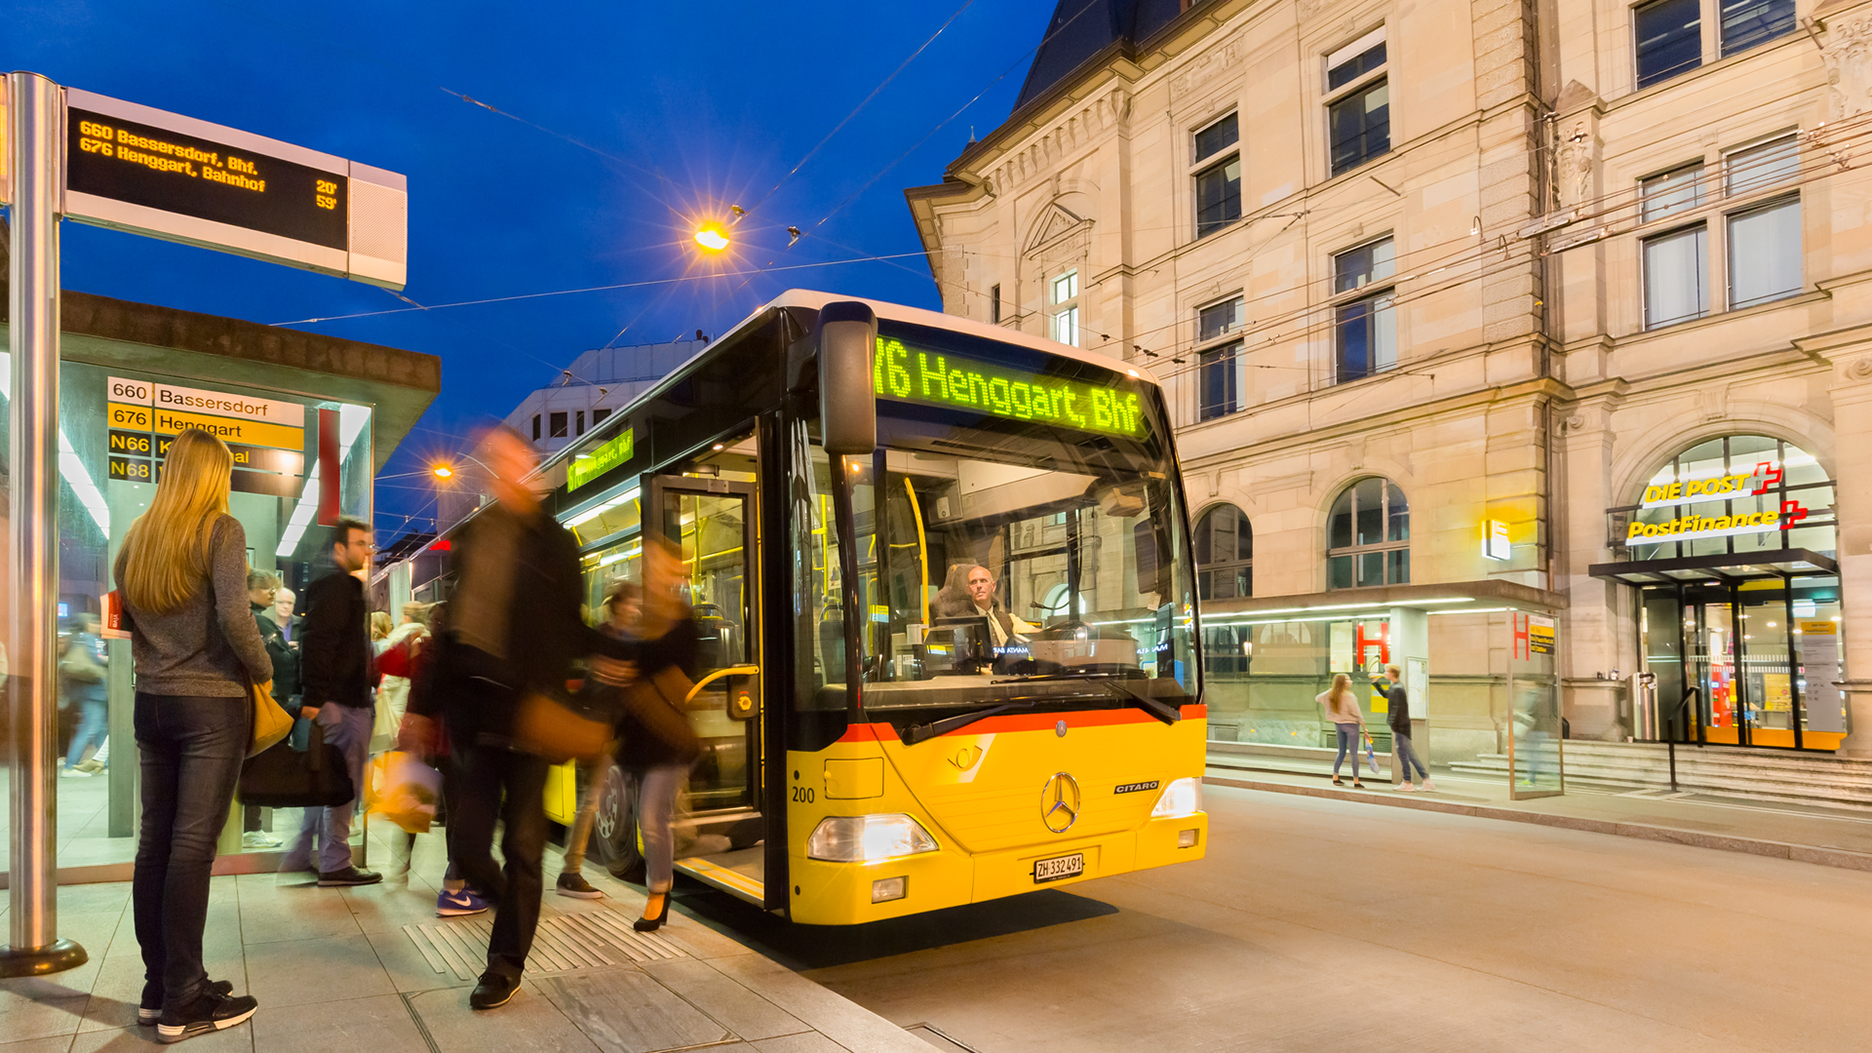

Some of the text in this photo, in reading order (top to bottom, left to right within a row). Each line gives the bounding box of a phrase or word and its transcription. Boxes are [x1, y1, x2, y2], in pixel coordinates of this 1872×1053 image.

[80, 120, 338, 195] 660 Bassersdorf, Bhf. 20'
[80, 137, 113, 156] 676
[117, 145, 197, 177] Henggart,
[202, 166, 266, 192] Bahnhof
[113, 383, 268, 416] 660 Bassersdorf
[918, 352, 1086, 428] Henggart,
[1090, 388, 1141, 432] Bhf
[113, 409, 147, 425] 676
[111, 434, 149, 452] N66
[111, 461, 149, 478] N68
[1645, 473, 1751, 503] DIE POST
[1627, 510, 1780, 540] PostFinance
[792, 785, 815, 804] 200
[1115, 781, 1158, 794] CITARO
[1038, 861, 1049, 878] ZH
